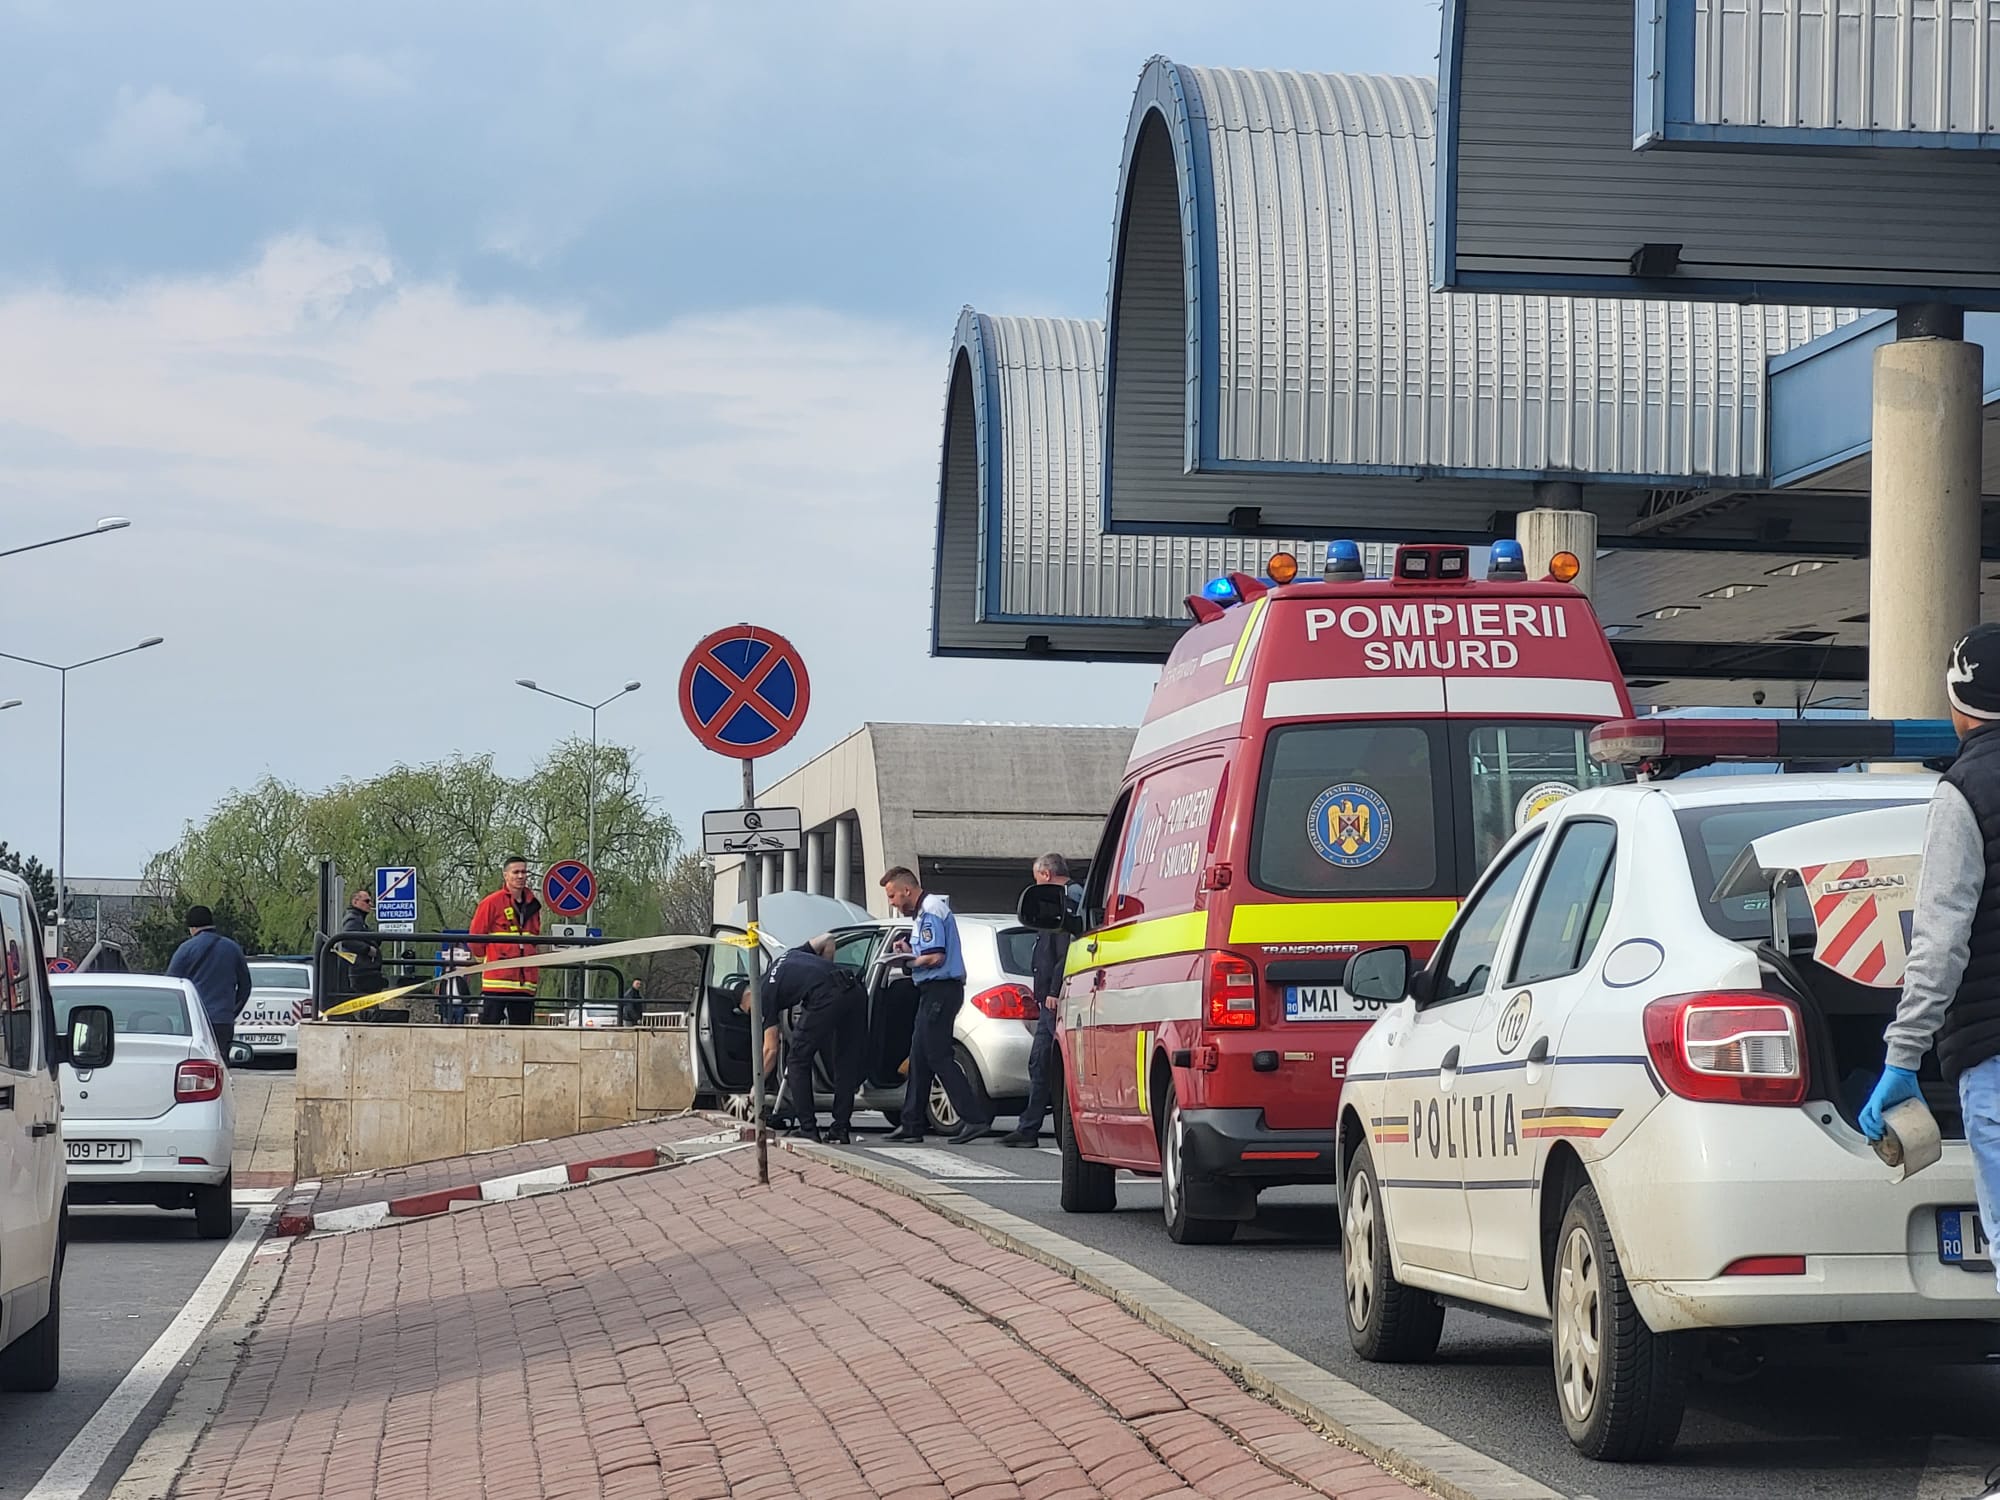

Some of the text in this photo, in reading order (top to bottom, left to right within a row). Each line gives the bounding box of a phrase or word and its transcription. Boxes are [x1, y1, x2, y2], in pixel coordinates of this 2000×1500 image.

[1305, 604, 1567, 641] POMPIERII
[1363, 640, 1519, 671] SMURD
[1164, 787, 1215, 837] POMPIERII
[1140, 815, 1163, 865] 112
[1164, 841, 1192, 879] SMURD
[1824, 875, 1905, 893] LOGAN
[1261, 944, 1359, 955] TRANSPORTER
[1286, 1003, 1298, 1013] RO
[1301, 989, 1338, 1013] MAI
[242, 1010, 291, 1021] OLITIA
[1505, 1012, 1525, 1043] 112
[66, 1143, 125, 1158] 109 PTJ
[1943, 1239, 1962, 1255] RO
